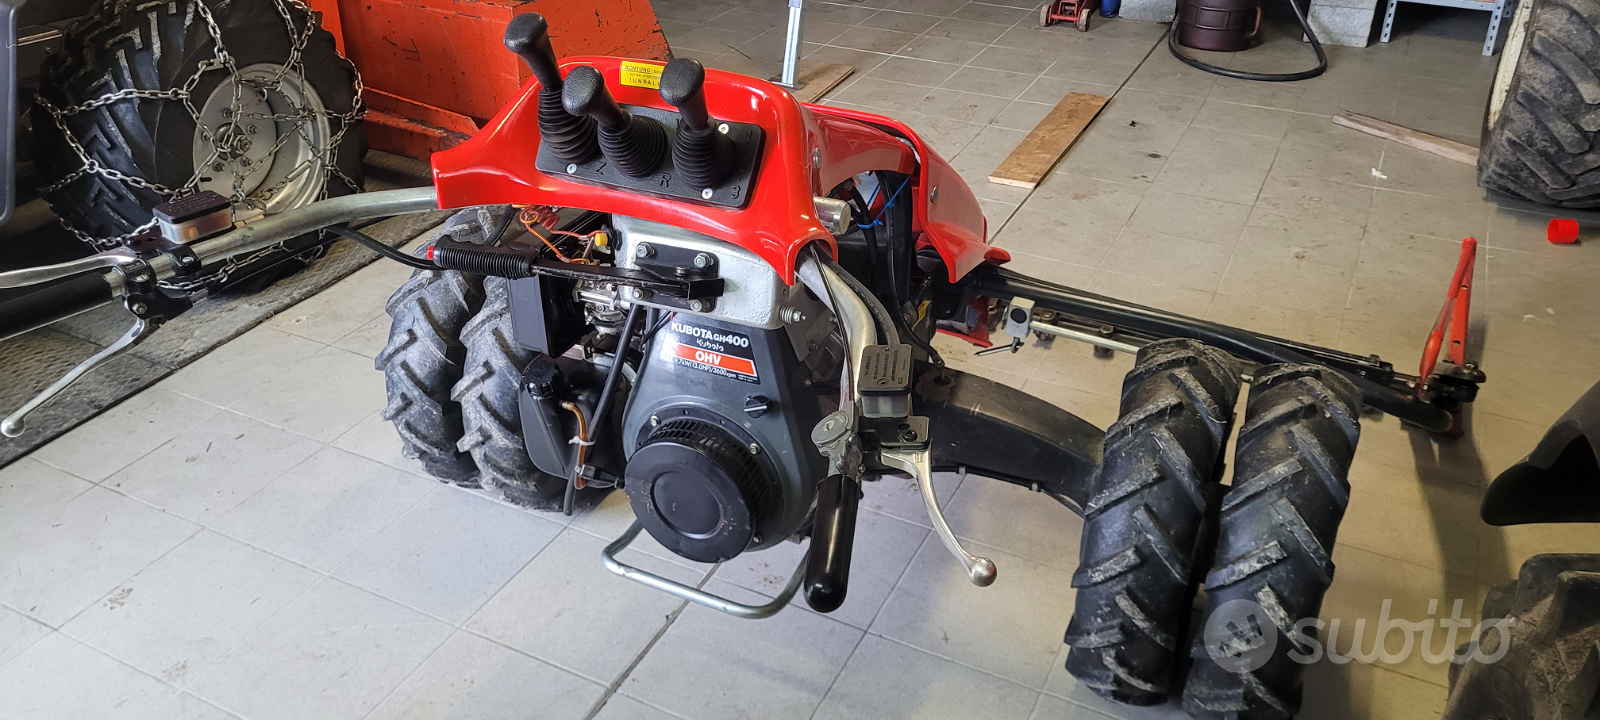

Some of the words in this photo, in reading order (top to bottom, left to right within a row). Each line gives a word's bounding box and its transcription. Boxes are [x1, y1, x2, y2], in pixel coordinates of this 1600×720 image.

[660, 172, 672, 187] R
[731, 184, 741, 200] 3
[671, 321, 713, 340] KUBOTA
[713, 333, 749, 348] GH400
[696, 338, 724, 352] Kubota
[695, 350, 722, 365] OHV
